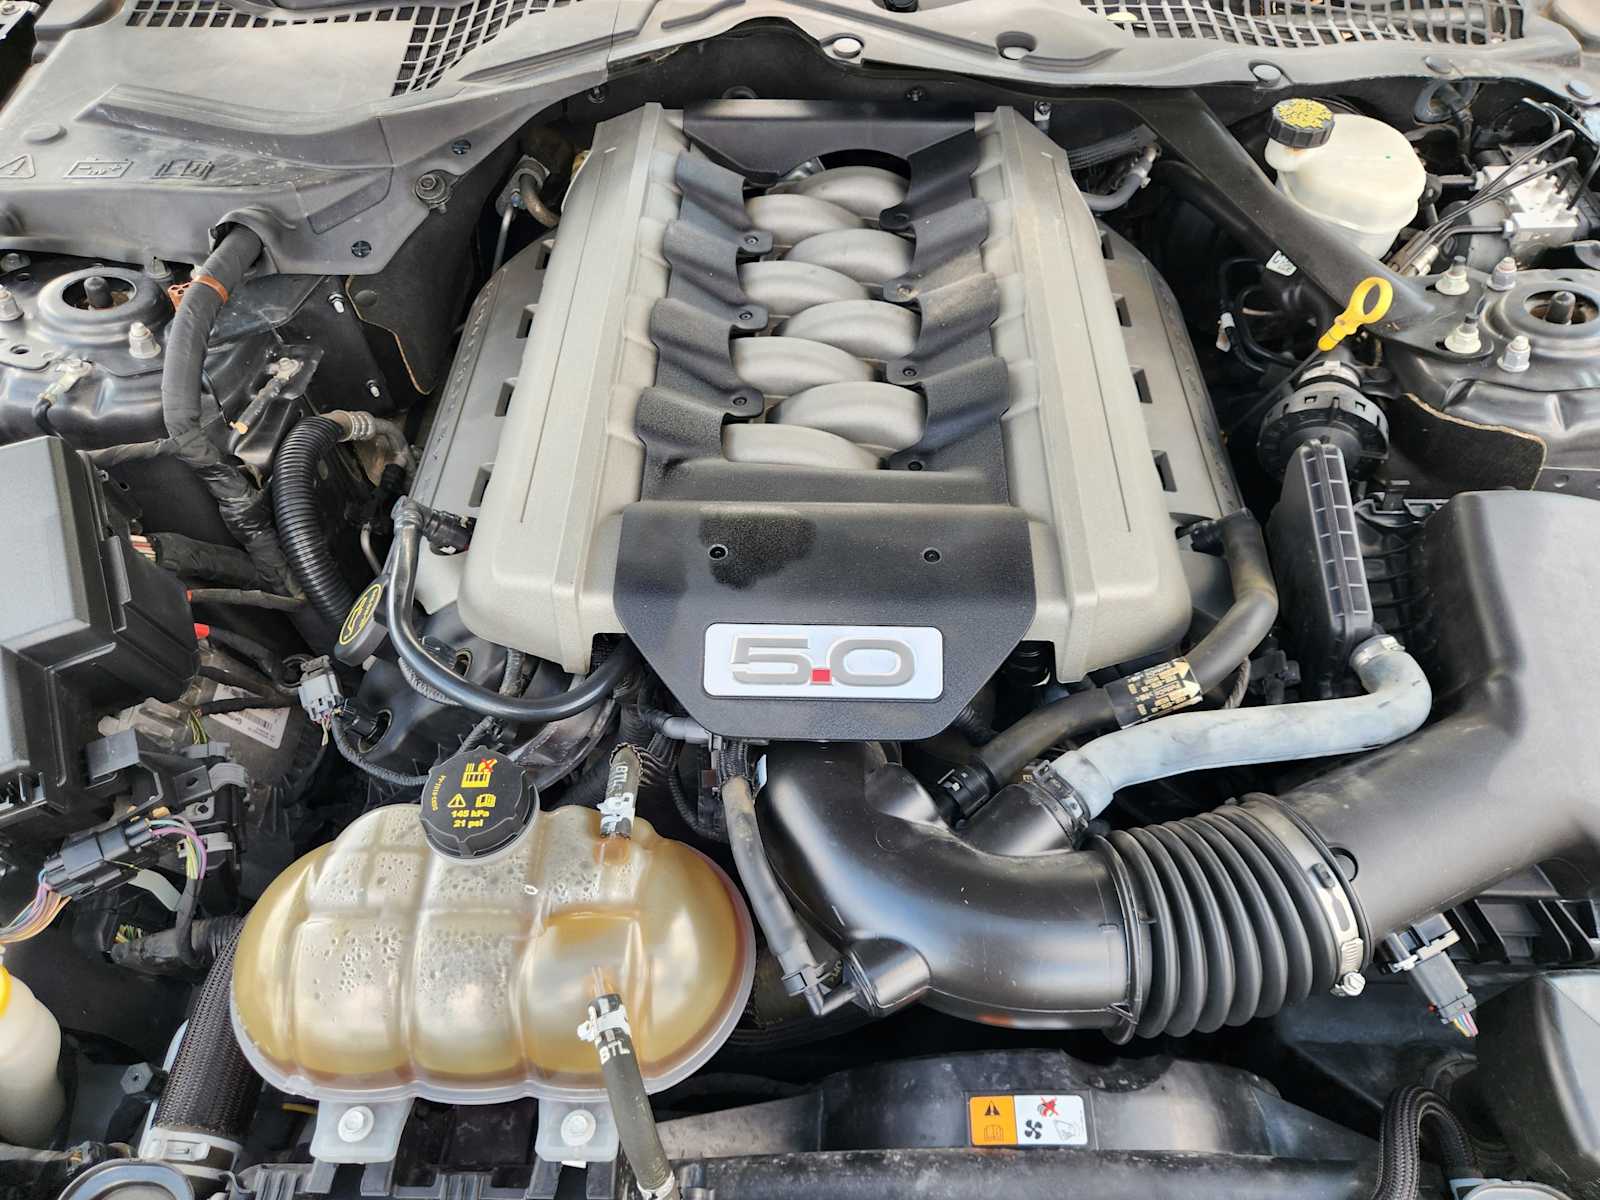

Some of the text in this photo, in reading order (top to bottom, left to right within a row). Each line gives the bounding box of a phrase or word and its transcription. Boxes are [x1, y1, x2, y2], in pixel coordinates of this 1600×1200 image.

[728, 634, 915, 687] 5.0
[451, 809, 469, 818] 145
[453, 818, 484, 829] 21 psi
[599, 1039, 631, 1065] BTL
